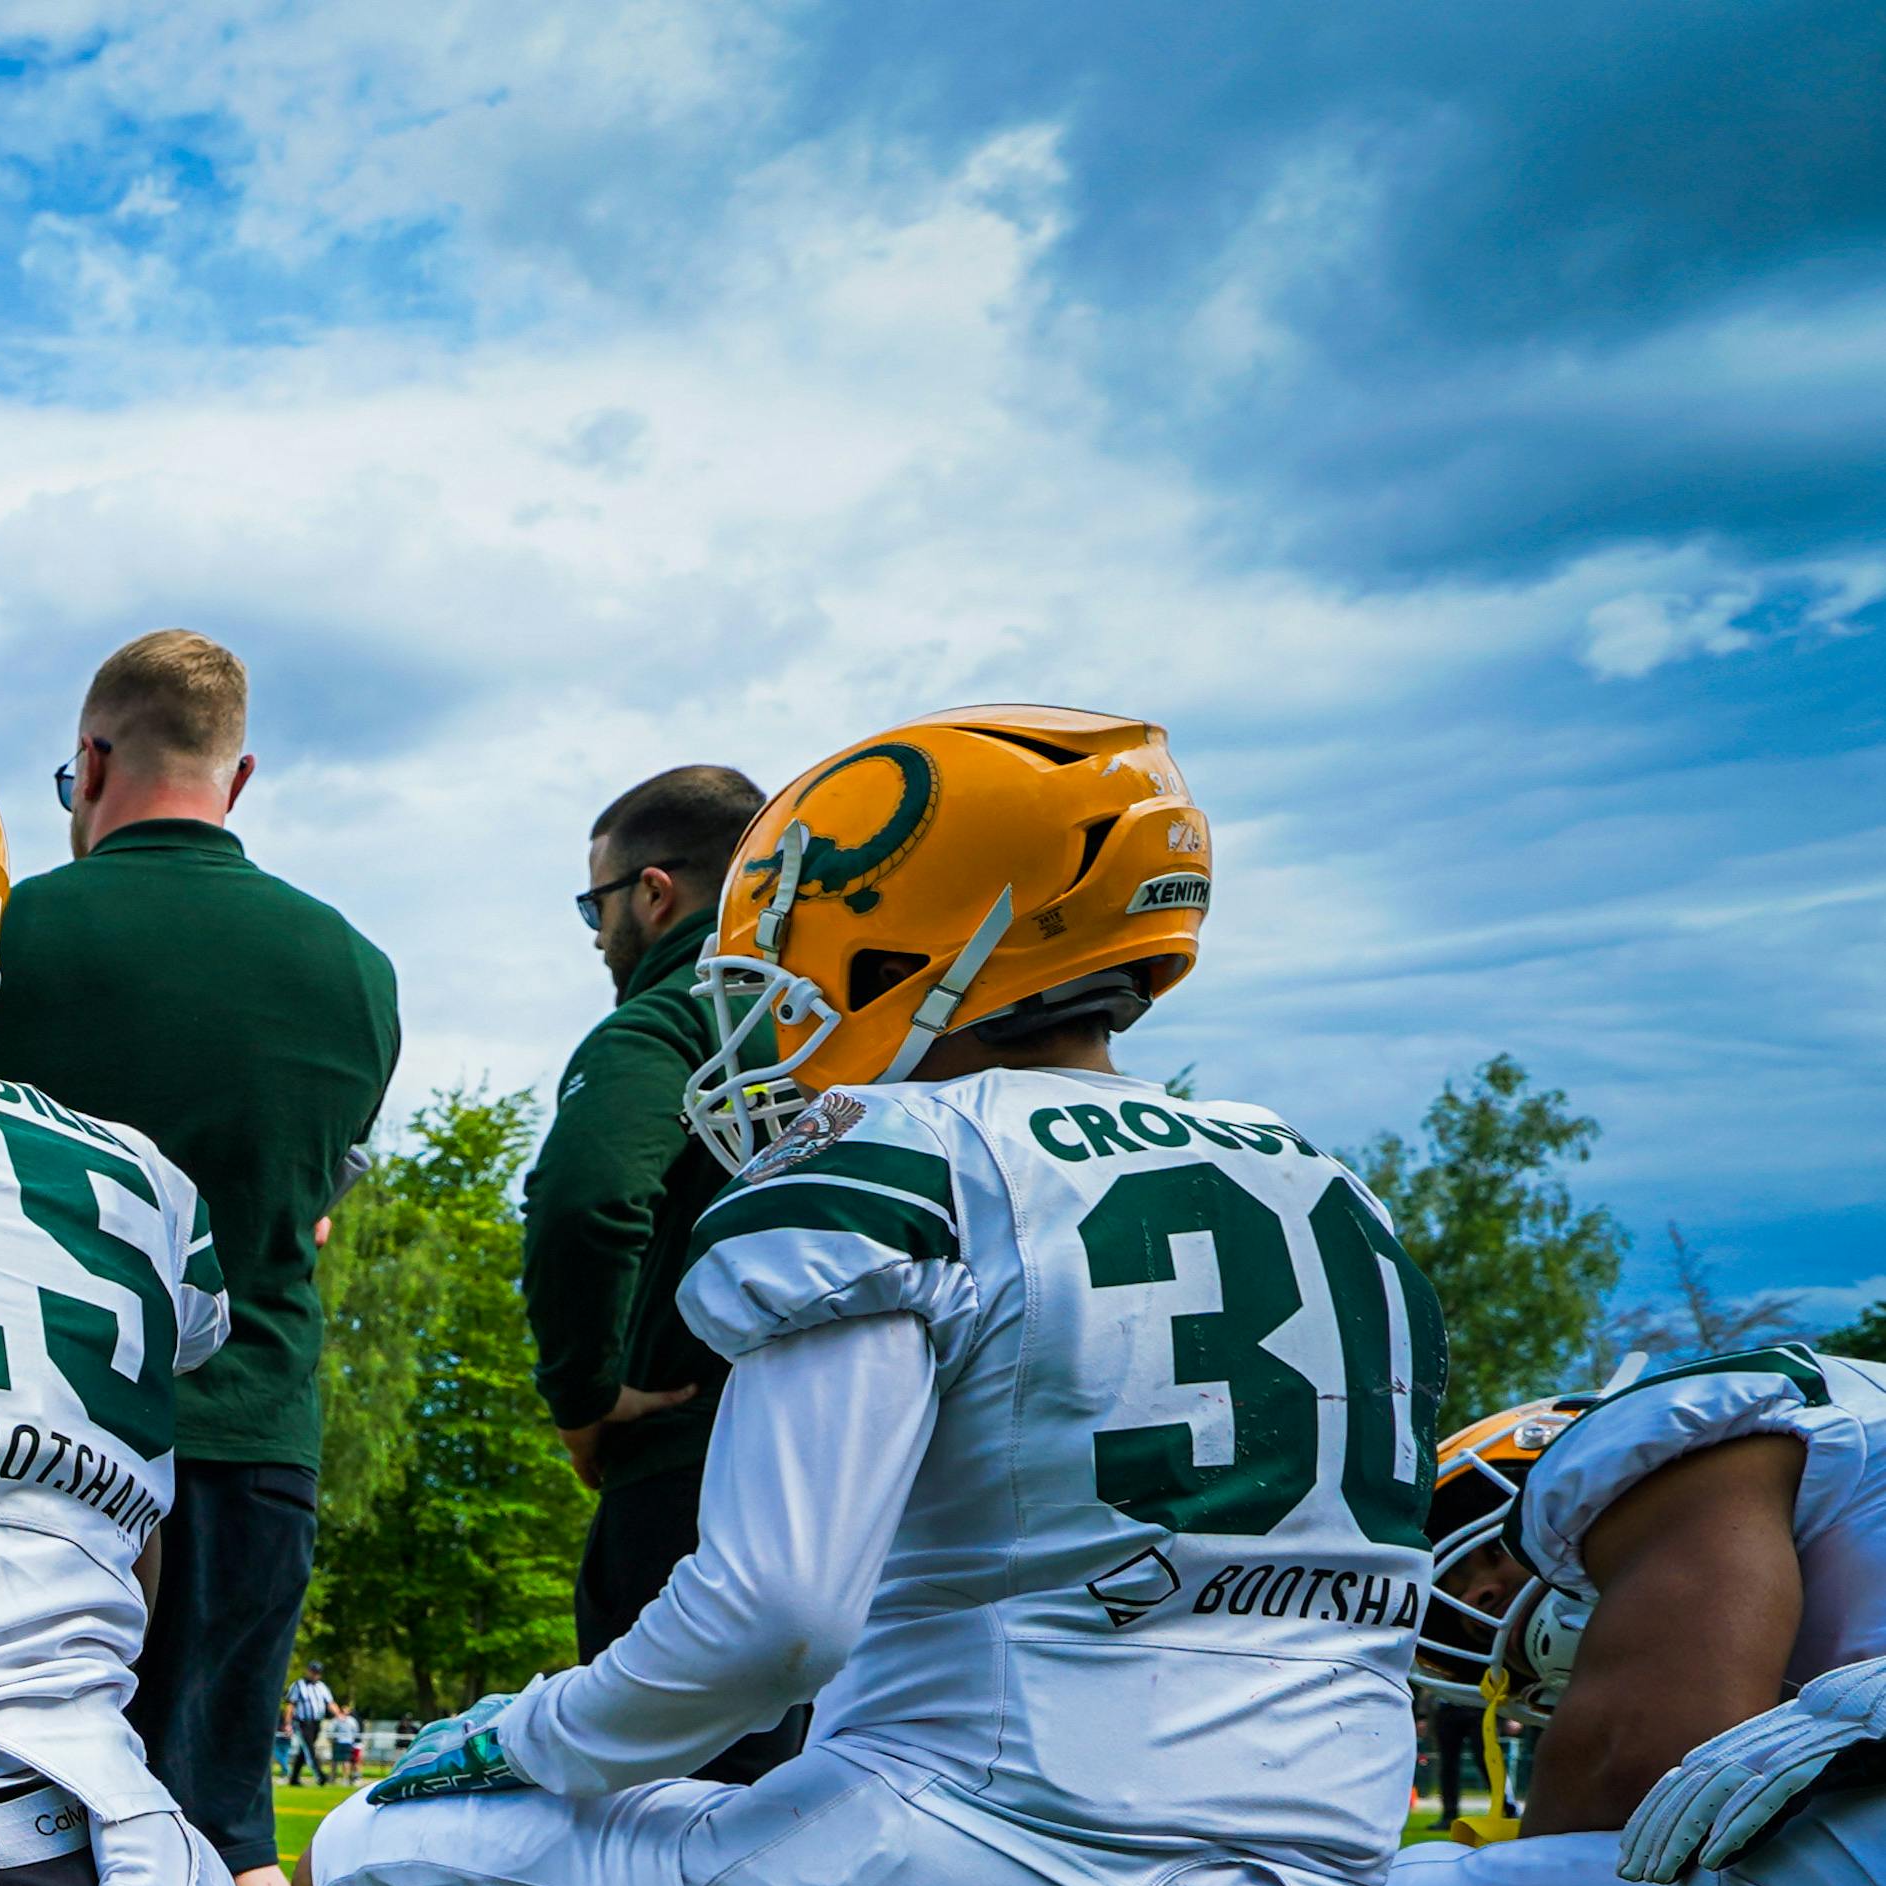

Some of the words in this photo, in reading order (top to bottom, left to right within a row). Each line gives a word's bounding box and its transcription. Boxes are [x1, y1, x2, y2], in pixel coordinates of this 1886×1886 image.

[1141, 880, 1211, 907] XENITH
[1078, 1161, 1448, 1552] 30
[1191, 1564, 1419, 1629] BOOTSHA
